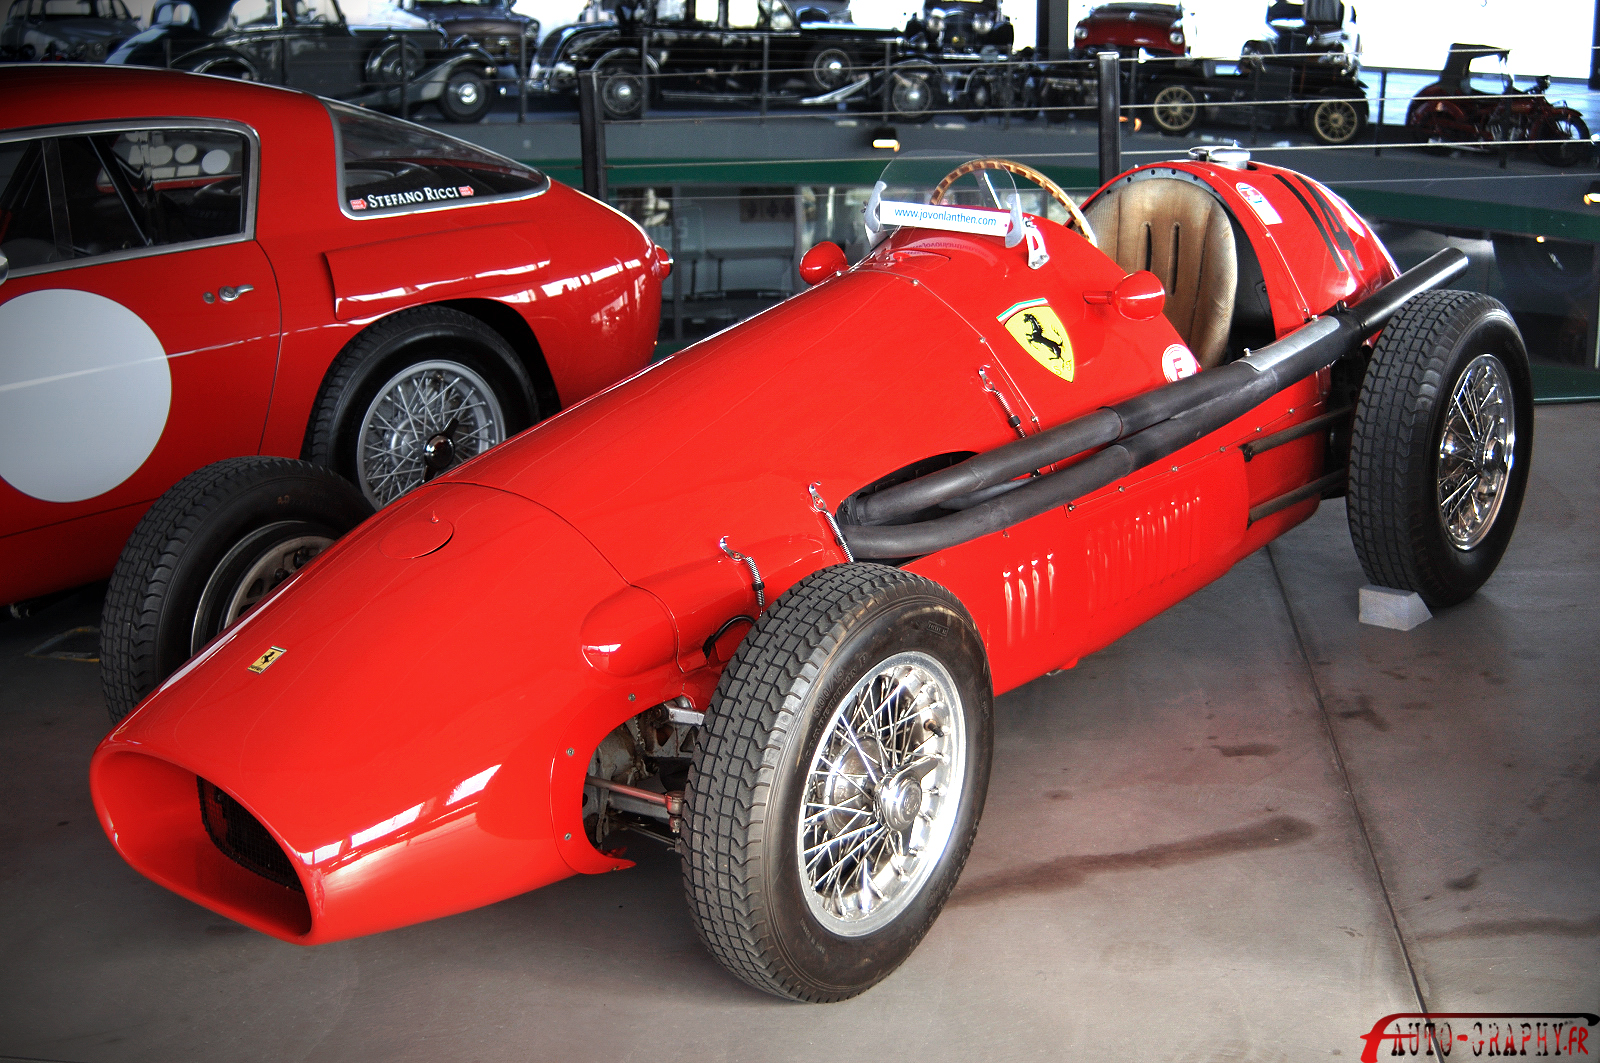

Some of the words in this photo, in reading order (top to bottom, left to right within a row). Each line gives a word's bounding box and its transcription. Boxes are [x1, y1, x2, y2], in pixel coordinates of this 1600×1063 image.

[367, 190, 424, 208] STEFANO
[423, 186, 459, 201] RICCI
[894, 208, 997, 226] www.jovonlanthen.com
[1272, 173, 1364, 271] 14
